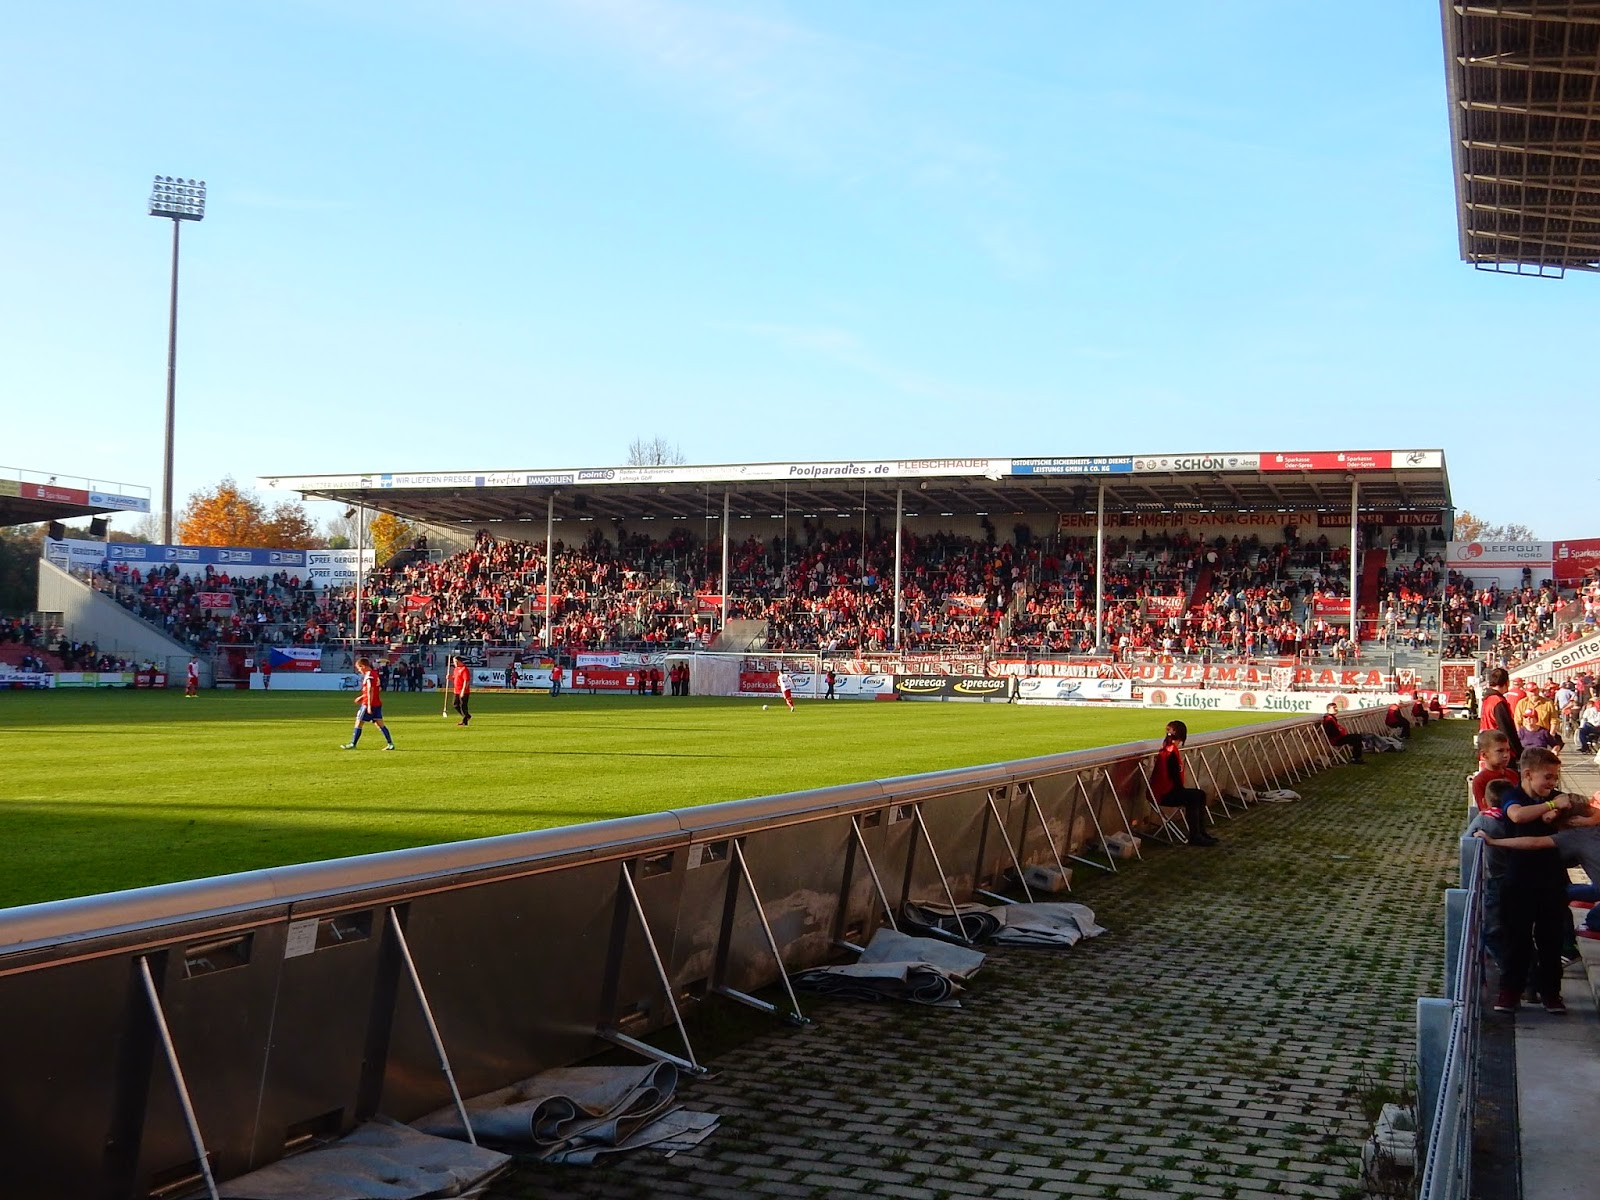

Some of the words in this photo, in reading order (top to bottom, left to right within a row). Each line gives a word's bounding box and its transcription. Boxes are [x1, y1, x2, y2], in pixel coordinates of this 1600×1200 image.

[898, 459, 988, 469] FLEISCHHAUER
[1241, 459, 1257, 467] Jeep
[411, 476, 441, 484] LIEFERN
[529, 475, 572, 484] IMMOBILIEN
[1061, 513, 1183, 527] SENFURENMAFIA
[1322, 514, 1383, 525] BERNER
[1396, 513, 1437, 524] JUNGZ
[1484, 545, 1542, 553] LEERGUT
[1552, 640, 1600, 669] senfte
[1000, 663, 1025, 676] LOVE
[1038, 664, 1052, 676] OR
[1054, 664, 1085, 677] LEAVE
[587, 678, 619, 686] Sparkasse
[742, 681, 776, 689] Sparkasse
[1174, 692, 1221, 709] Lübzer
[1263, 694, 1312, 712] Lübzer
